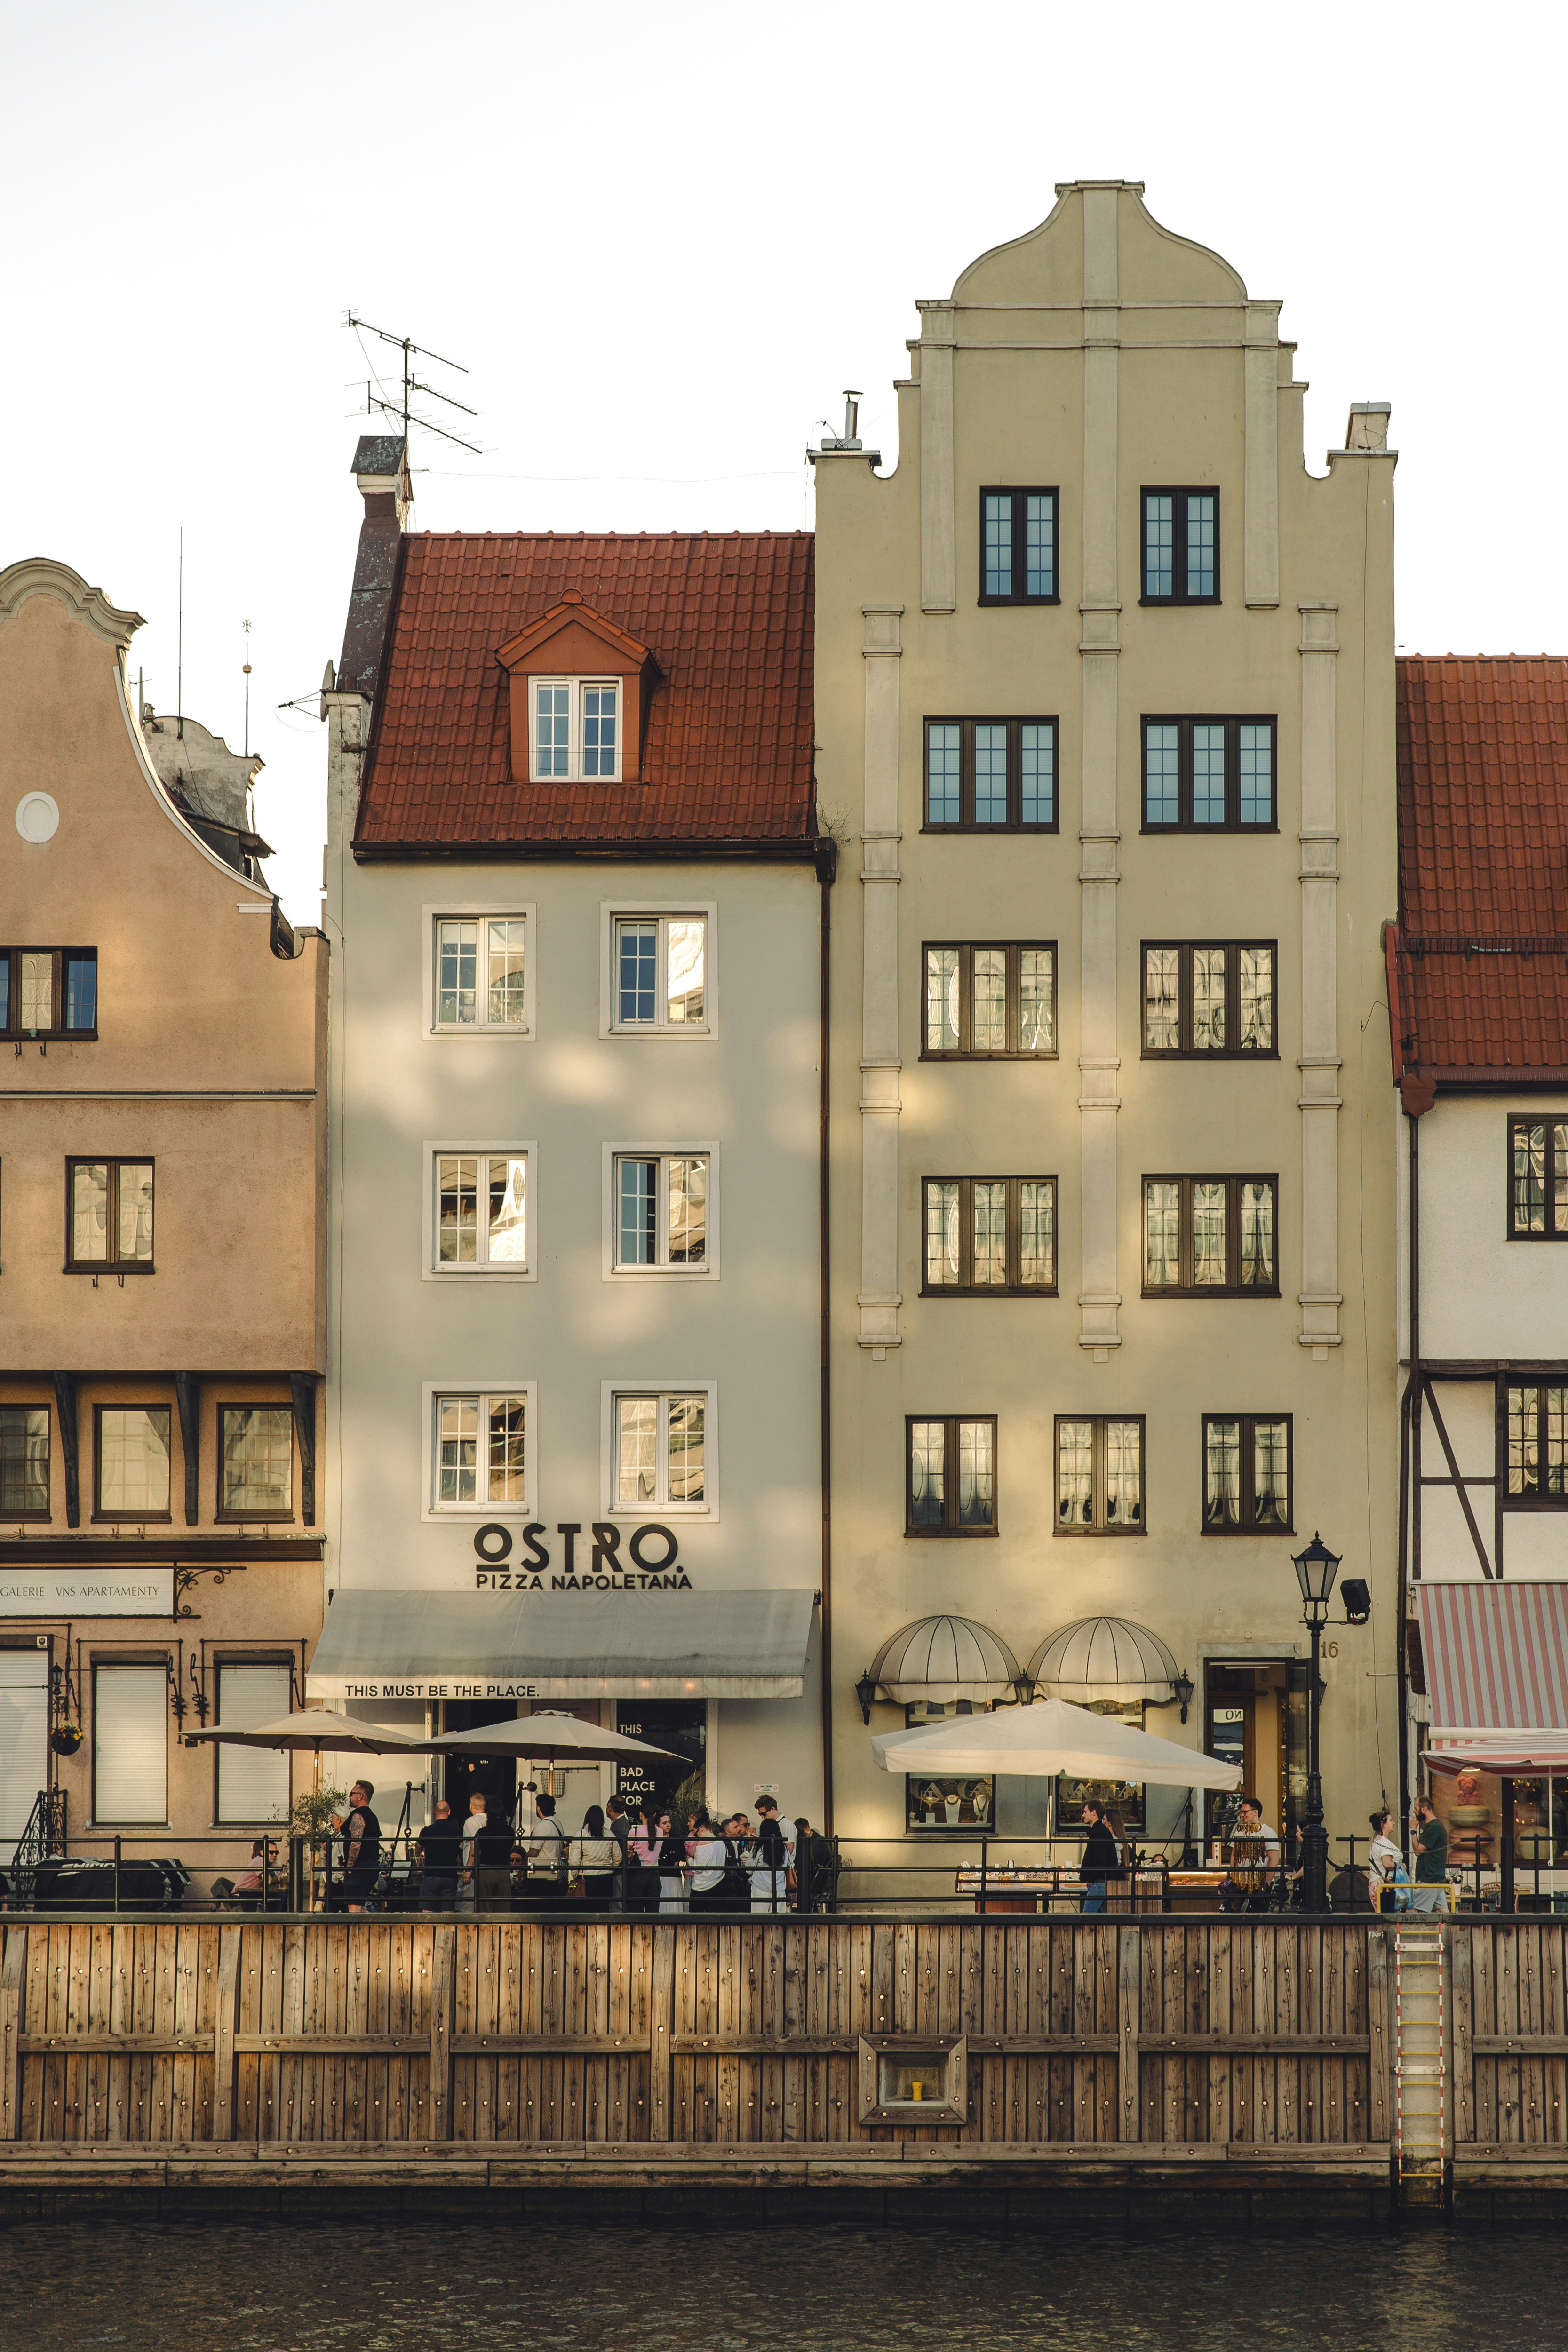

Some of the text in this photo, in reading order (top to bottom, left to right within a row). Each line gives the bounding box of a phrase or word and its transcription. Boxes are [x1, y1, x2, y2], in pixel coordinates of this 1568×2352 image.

[476, 1574, 692, 1590] PIZZA NAPOLETANA
[0, 1587, 45, 1597] GALERIE
[56, 1587, 159, 1596] VNS APARTAMENTY
[1321, 1641, 1339, 1658] 16
[345, 1685, 540, 1697] THIS MUST BE THE PLACE.
[620, 1724, 642, 1734] THIS
[620, 1767, 644, 1777] BAD
[620, 1781, 655, 1791] PLACE
[621, 1796, 642, 1805] OR
